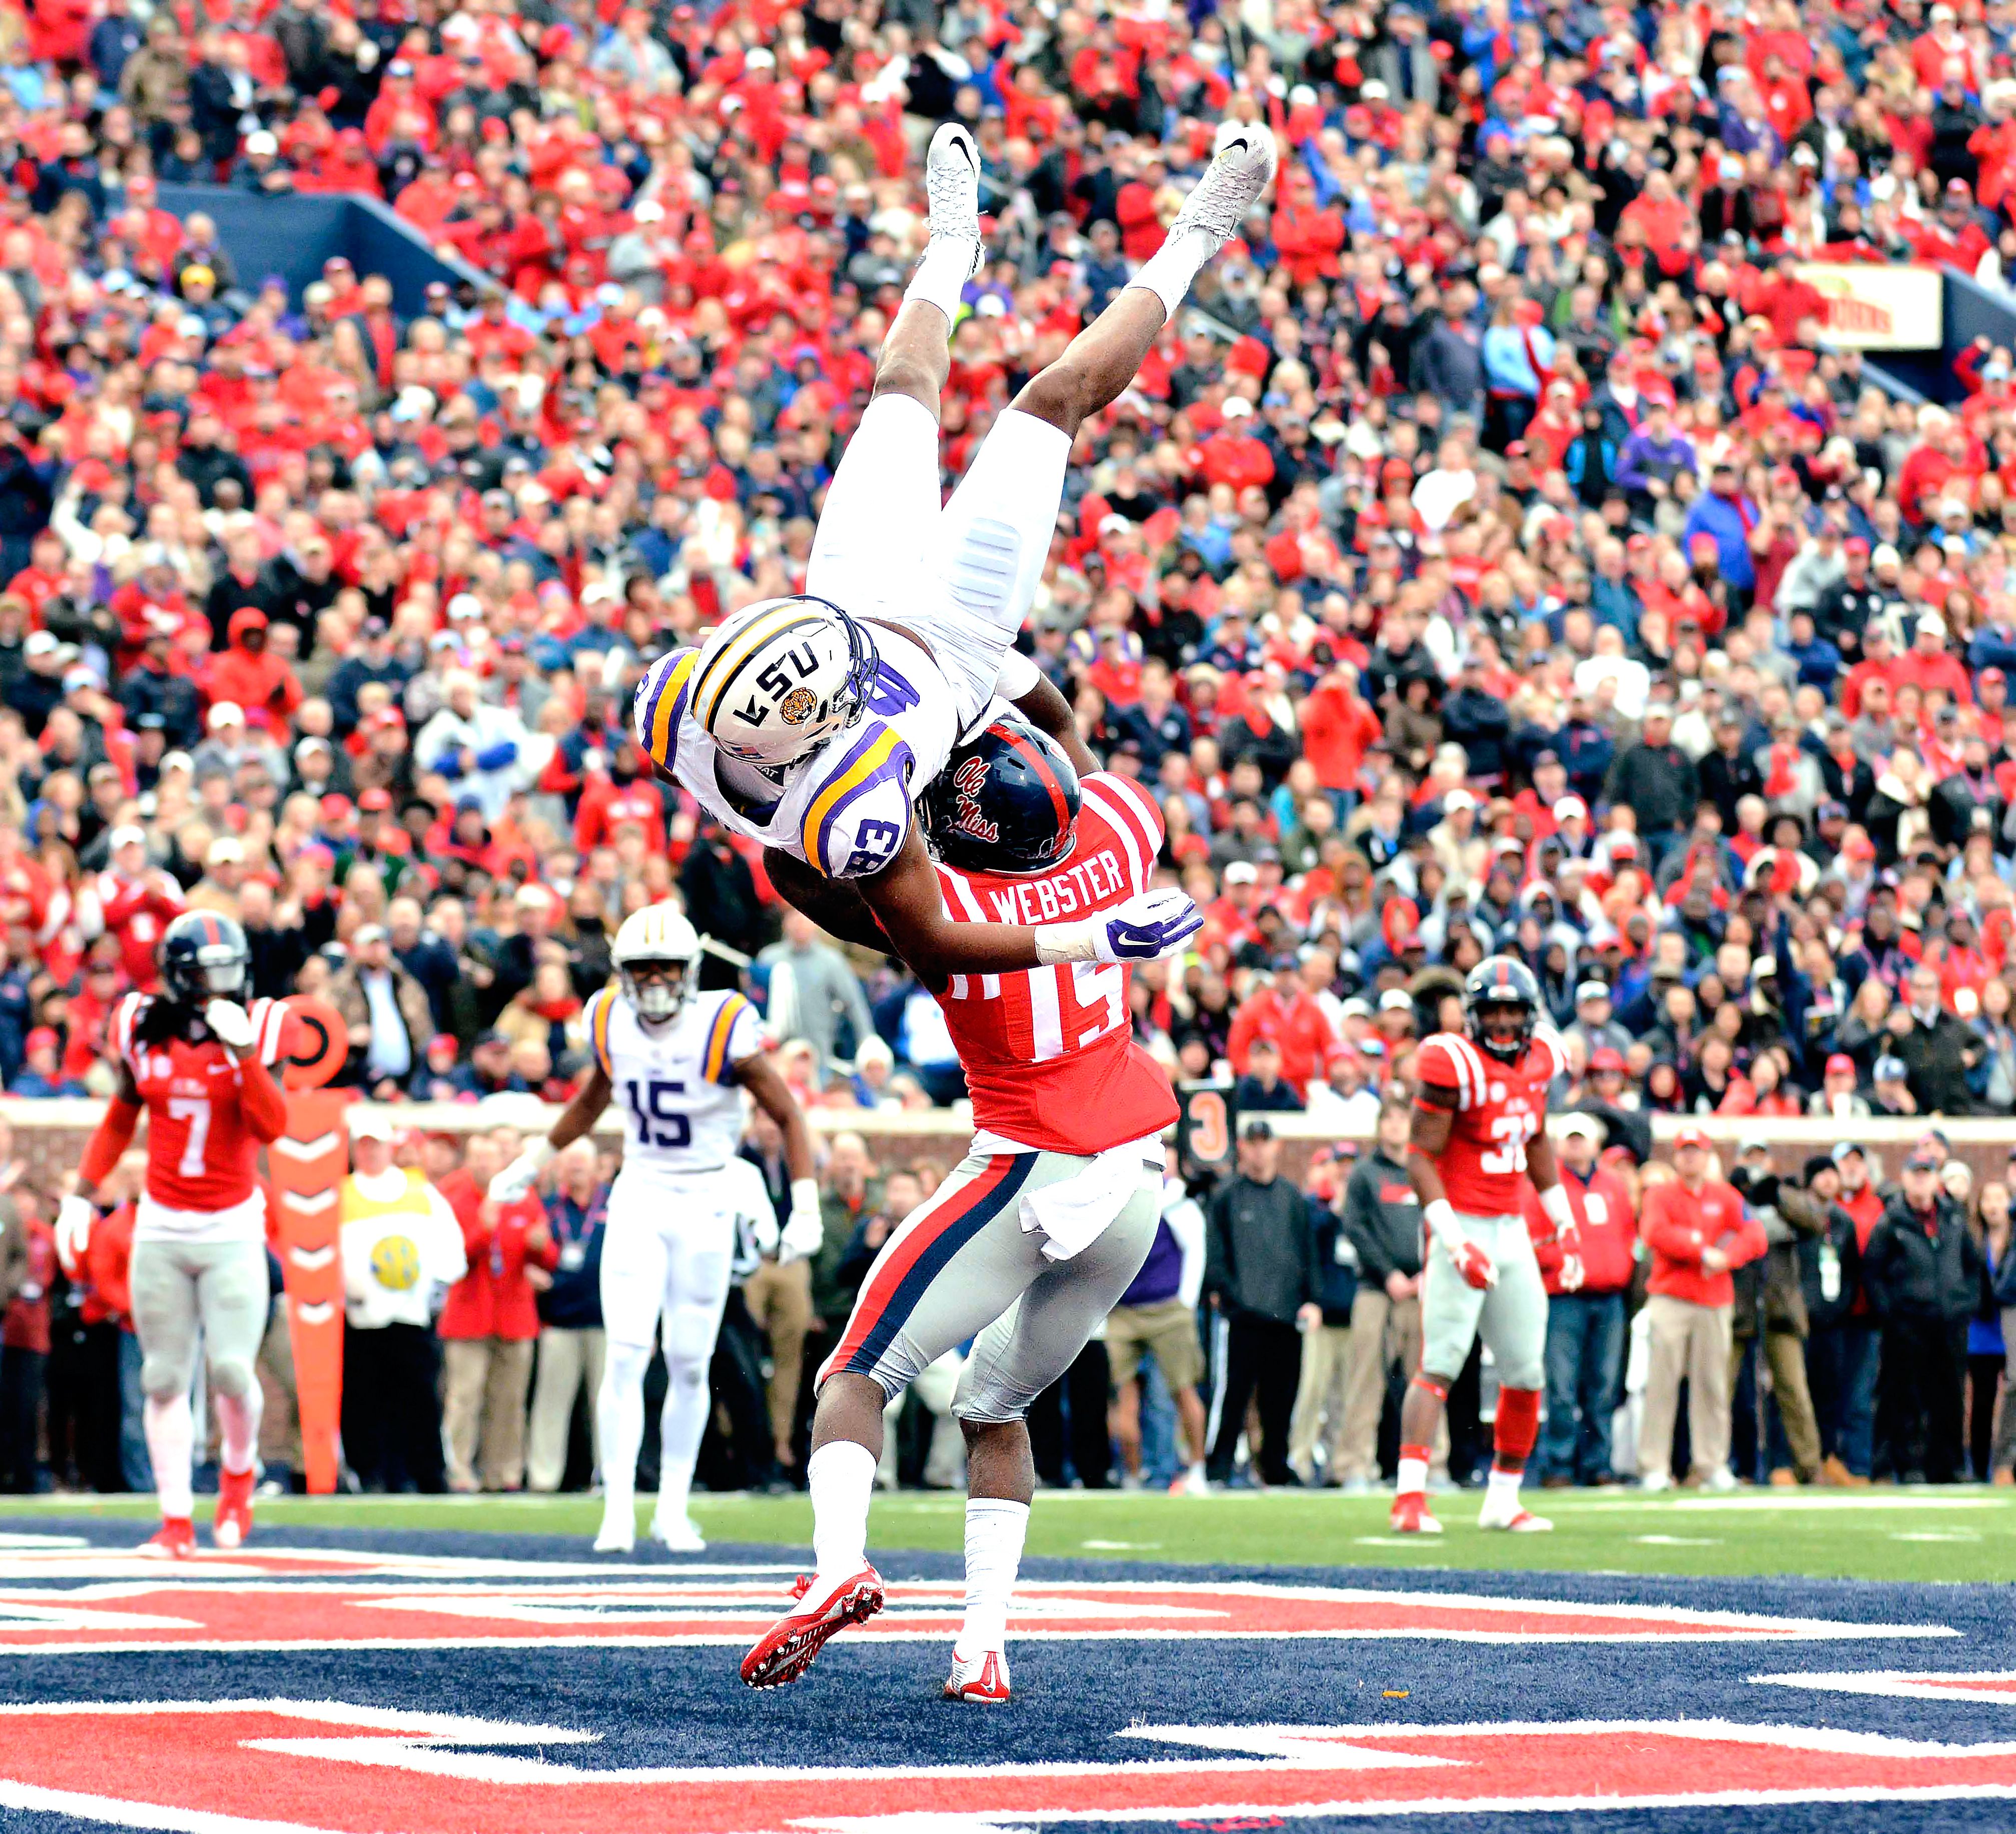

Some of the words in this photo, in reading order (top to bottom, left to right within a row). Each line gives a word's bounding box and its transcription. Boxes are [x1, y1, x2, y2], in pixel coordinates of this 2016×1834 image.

[733, 642, 819, 727] LSU
[954, 756, 991, 797] Ole
[841, 818, 900, 875] 83
[956, 794, 999, 843] Miss
[989, 850, 1124, 925] WEBSTER
[168, 1098, 211, 1177] 7
[625, 1080, 691, 1147] 15
[1188, 1091, 1229, 1162] 3
[1480, 1111, 1538, 1174] 31
